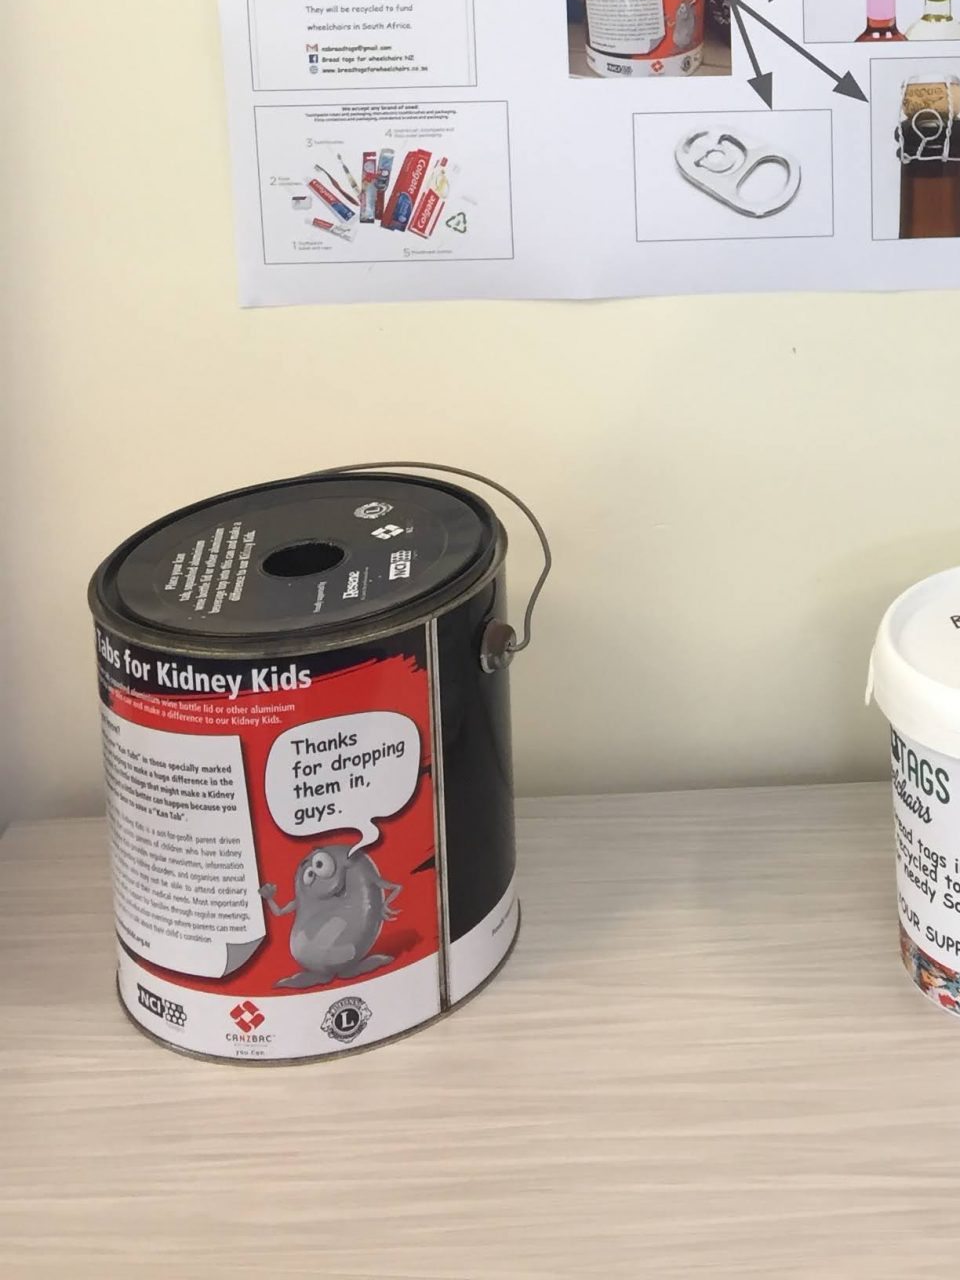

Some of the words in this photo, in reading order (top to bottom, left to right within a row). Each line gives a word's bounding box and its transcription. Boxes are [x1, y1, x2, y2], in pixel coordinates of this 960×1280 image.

[305, 6, 324, 15] They
[326, 5, 339, 13] will
[340, 5, 350, 13] be
[352, 4, 384, 14] recycled
[396, 4, 413, 12] fund
[418, 195, 436, 228] Colgate
[342, 570, 360, 599] Resene
[124, 649, 151, 682] for
[157, 661, 242, 700] Kidney
[251, 663, 312, 693] Kids
[179, 701, 202, 713] bottle
[203, 704, 214, 714] lid
[215, 706, 224, 714] or
[225, 704, 248, 714] other
[251, 703, 296, 714] aluminium
[167, 710, 203, 724] difference
[205, 716, 214, 724] to
[231, 716, 260, 727] Kidney
[262, 716, 283, 725] Kids.
[291, 732, 358, 756] Thanks
[292, 761, 322, 778] for
[331, 741, 405, 771] dropping
[169, 762, 199, 774] specially
[201, 765, 232, 773] marked
[897, 735, 950, 805] TAGS
[172, 773, 208, 785] difference
[293, 781, 341, 799] them
[350, 774, 371, 789] in,
[181, 789, 201, 798] make
[208, 791, 235, 800] Kidney
[190, 801, 221, 811] because
[222, 805, 237, 813] you
[294, 803, 343, 825] guys.
[196, 837, 217, 845] parent
[219, 849, 242, 859] kidney
[917, 839, 947, 869] tags
[222, 874, 246, 882] annual
[904, 864, 936, 903] needy
[218, 887, 247, 896] ordinary
[218, 912, 250, 921] meetings,
[229, 924, 246, 932] meet
[140, 991, 161, 1016] NCI
[340, 1011, 355, 1028] L
[226, 1033, 272, 1043] CANZBAC
